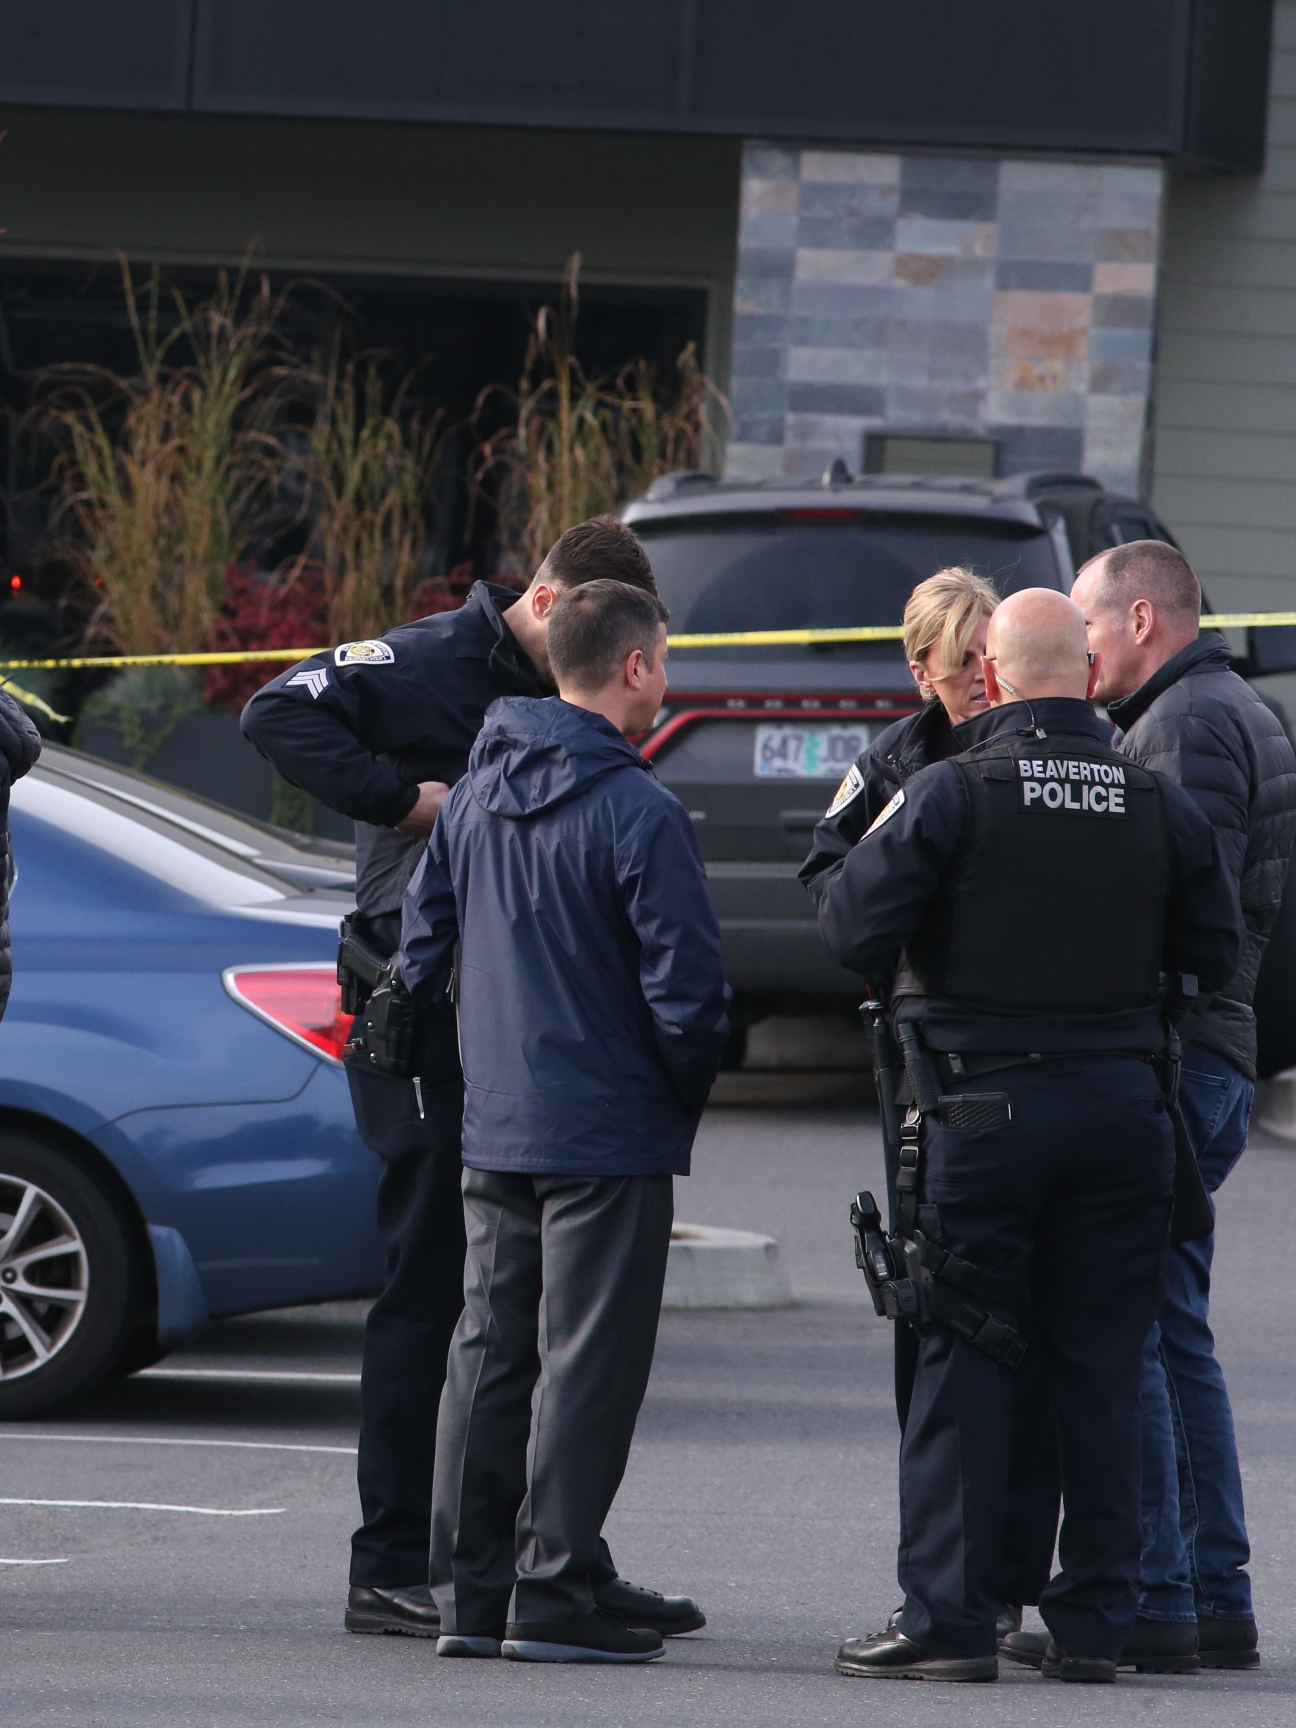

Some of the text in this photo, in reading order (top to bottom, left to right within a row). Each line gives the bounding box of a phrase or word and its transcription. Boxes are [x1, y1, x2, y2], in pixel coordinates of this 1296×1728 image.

[761, 733, 804, 762] 647
[1018, 759, 1126, 785] BEAVERTON
[1023, 781, 1126, 813] POLICE
